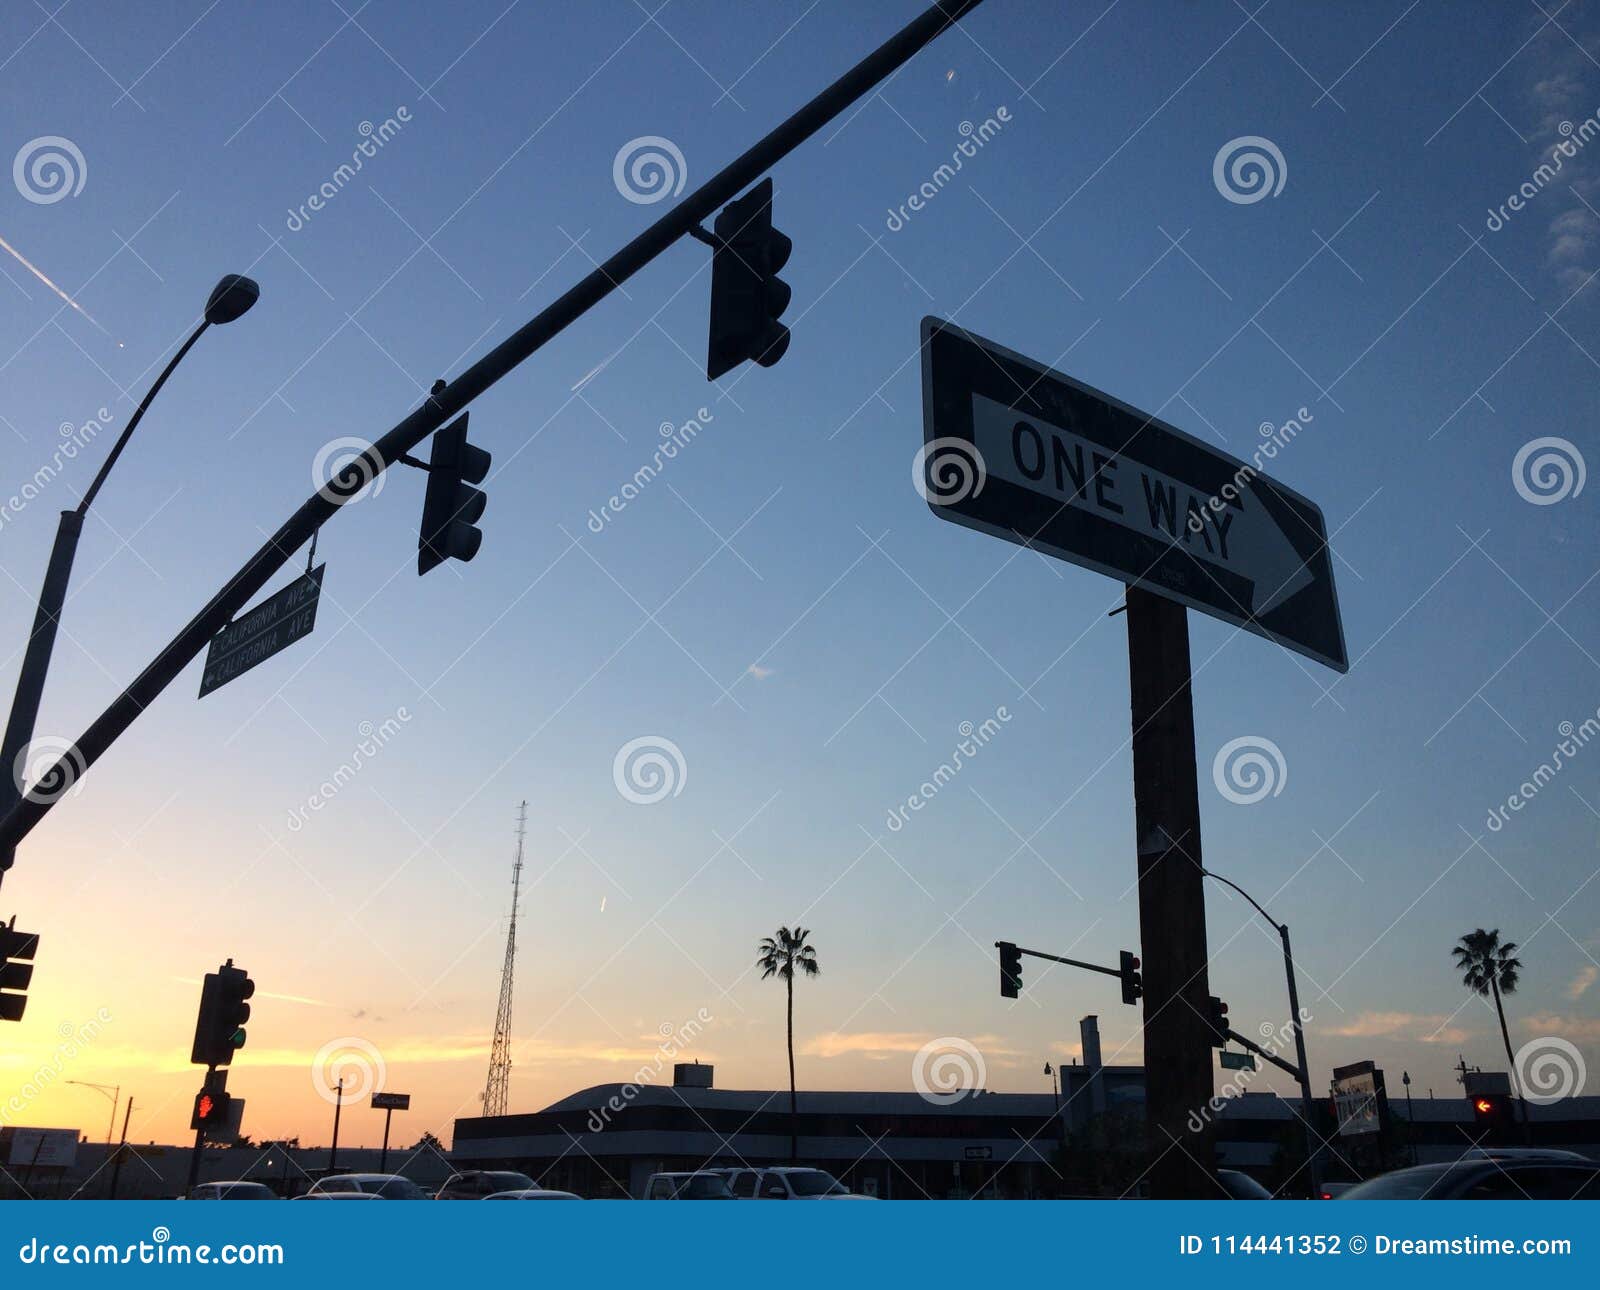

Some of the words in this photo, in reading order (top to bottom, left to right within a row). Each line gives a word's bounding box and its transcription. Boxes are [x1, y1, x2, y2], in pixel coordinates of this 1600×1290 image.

[1011, 420, 1124, 515] ONE
[1141, 472, 1234, 560] WAY
[216, 630, 278, 682] CALIFORNIA
[287, 610, 312, 639] AVE
[220, 603, 278, 652] CALIFORNIA
[286, 581, 307, 609] AVE
